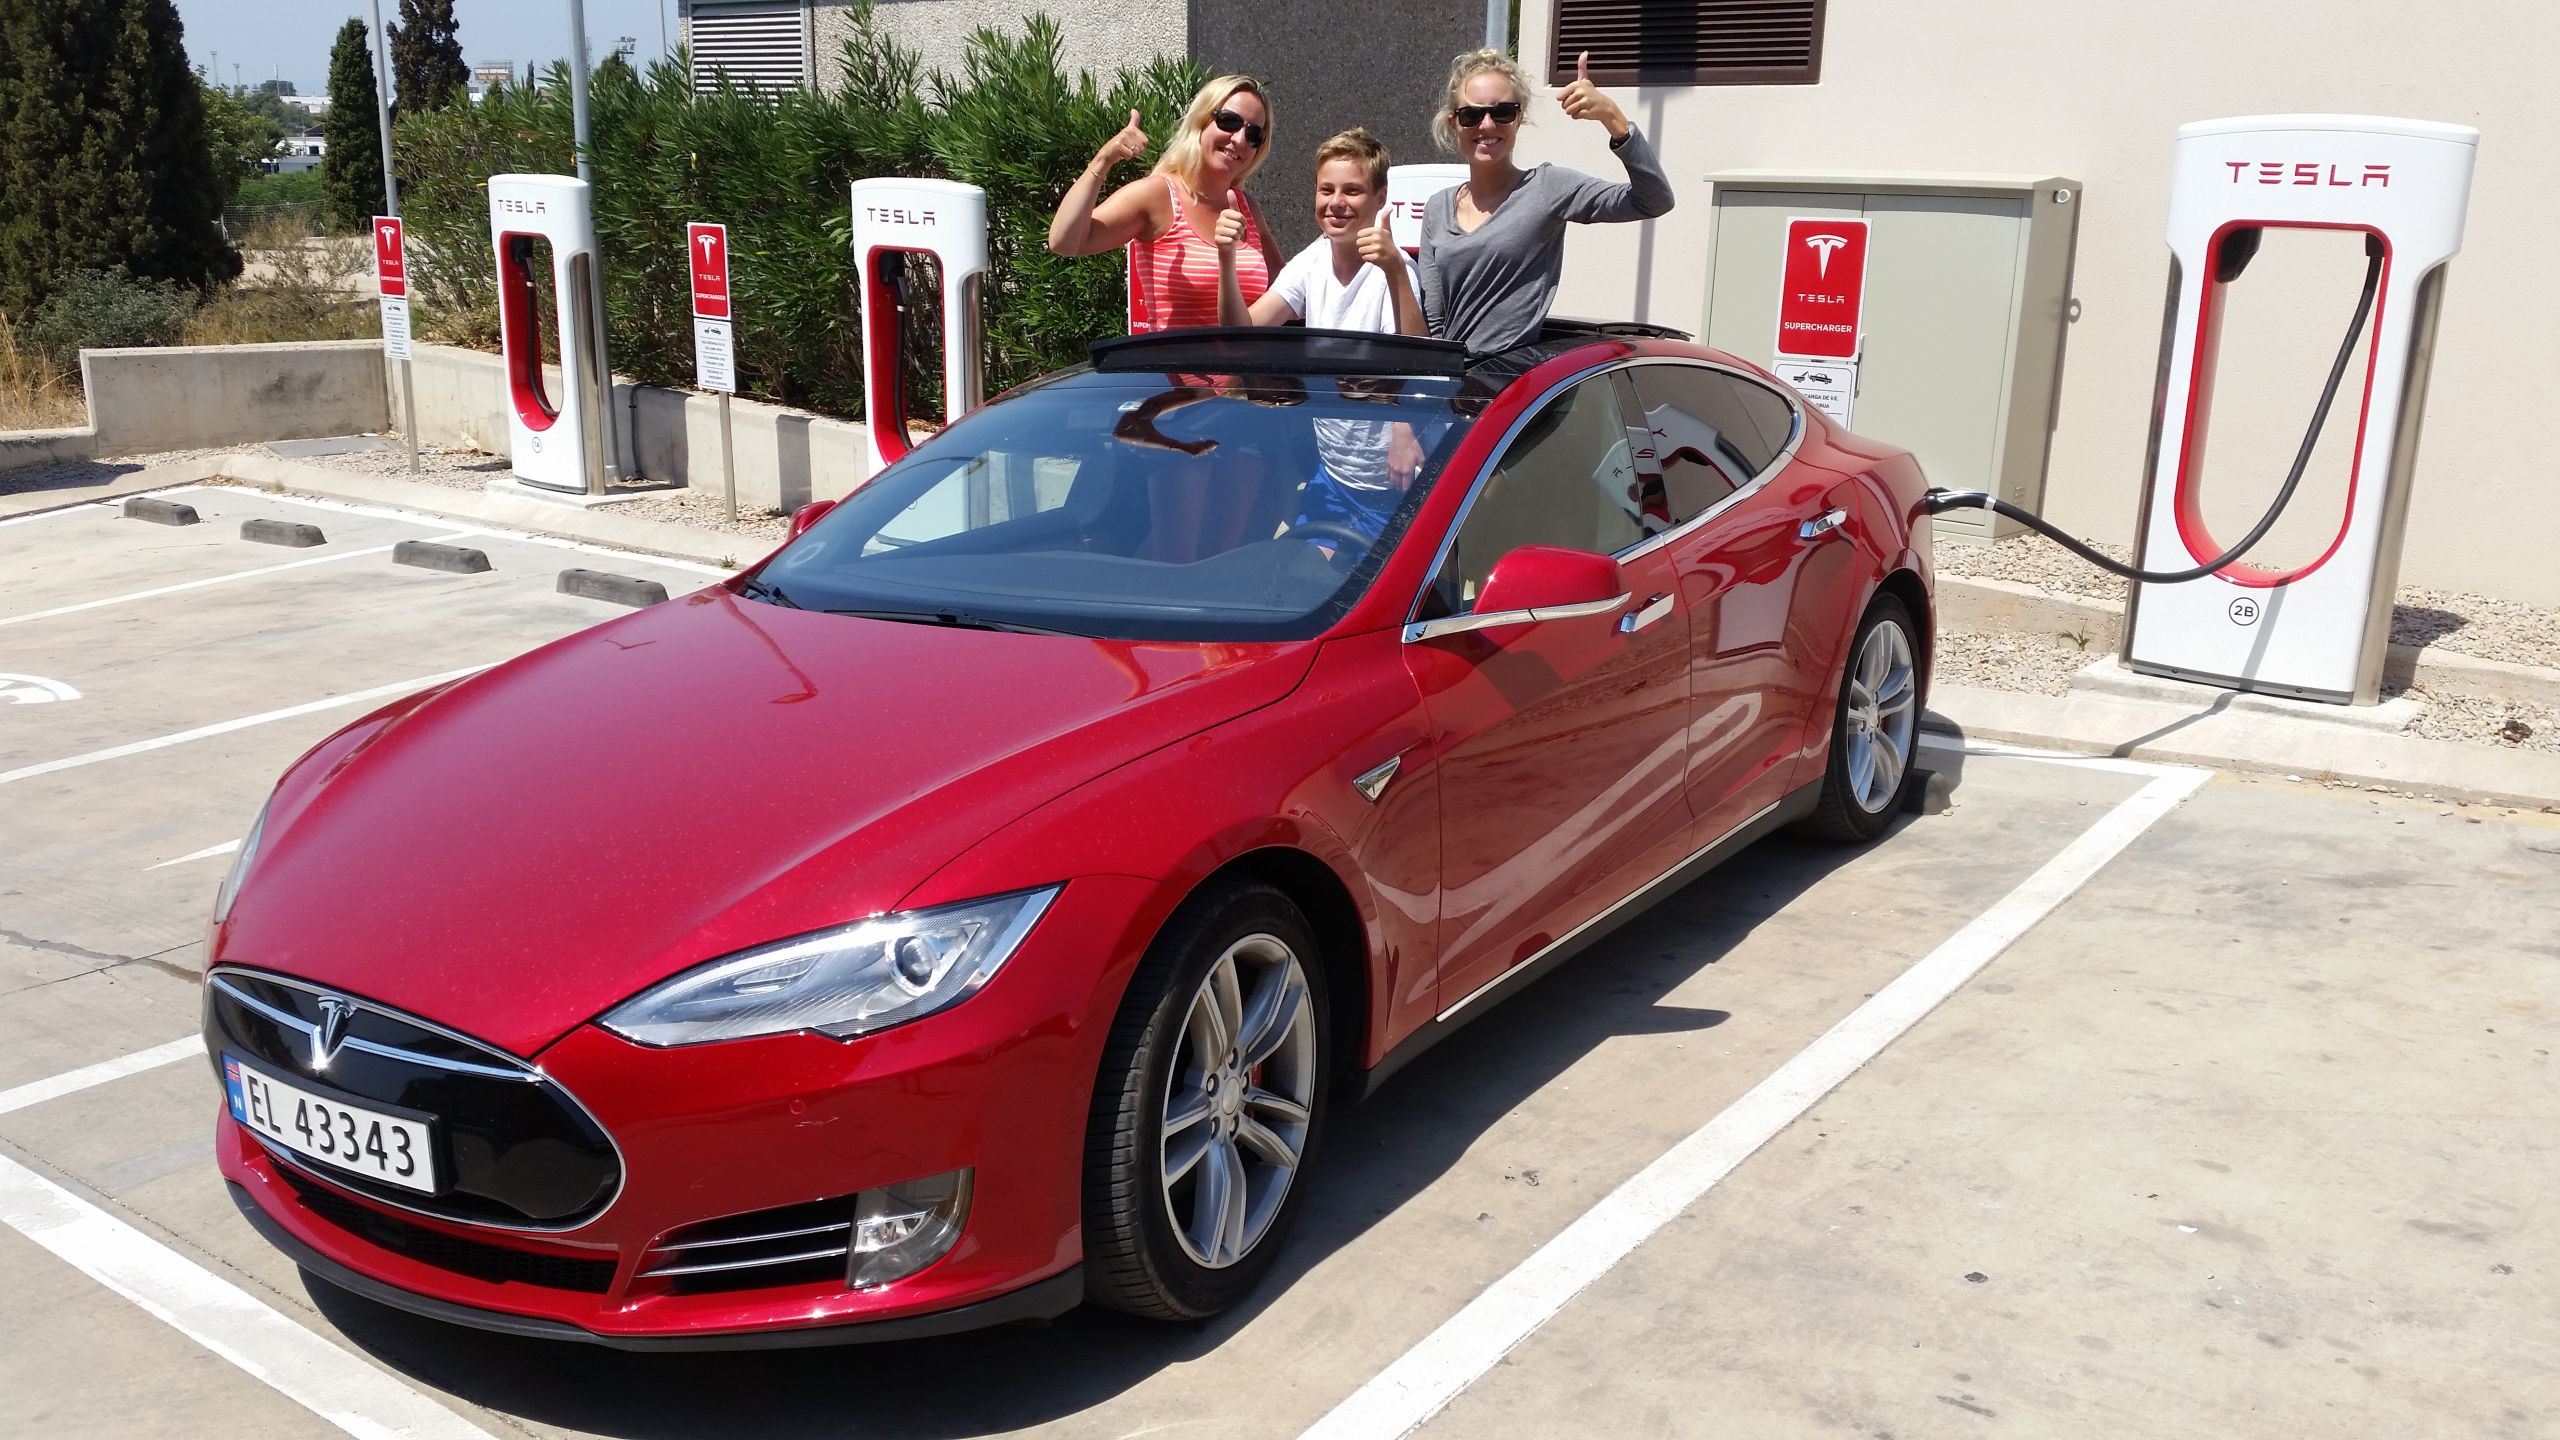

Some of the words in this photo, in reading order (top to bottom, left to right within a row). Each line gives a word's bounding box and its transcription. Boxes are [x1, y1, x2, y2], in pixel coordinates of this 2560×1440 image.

[2226, 162, 2391, 187] TESLA
[497, 199, 546, 215] TESLA
[867, 207, 936, 226] TESLA
[698, 273, 721, 282] TESLA
[1797, 293, 1845, 304] TESLA
[1784, 321, 1853, 333] SUPERCHARGER
[2234, 605, 2254, 617] 2B
[234, 1095, 243, 1111] N
[247, 1074, 282, 1135] EL
[295, 1098, 415, 1177] 43343
